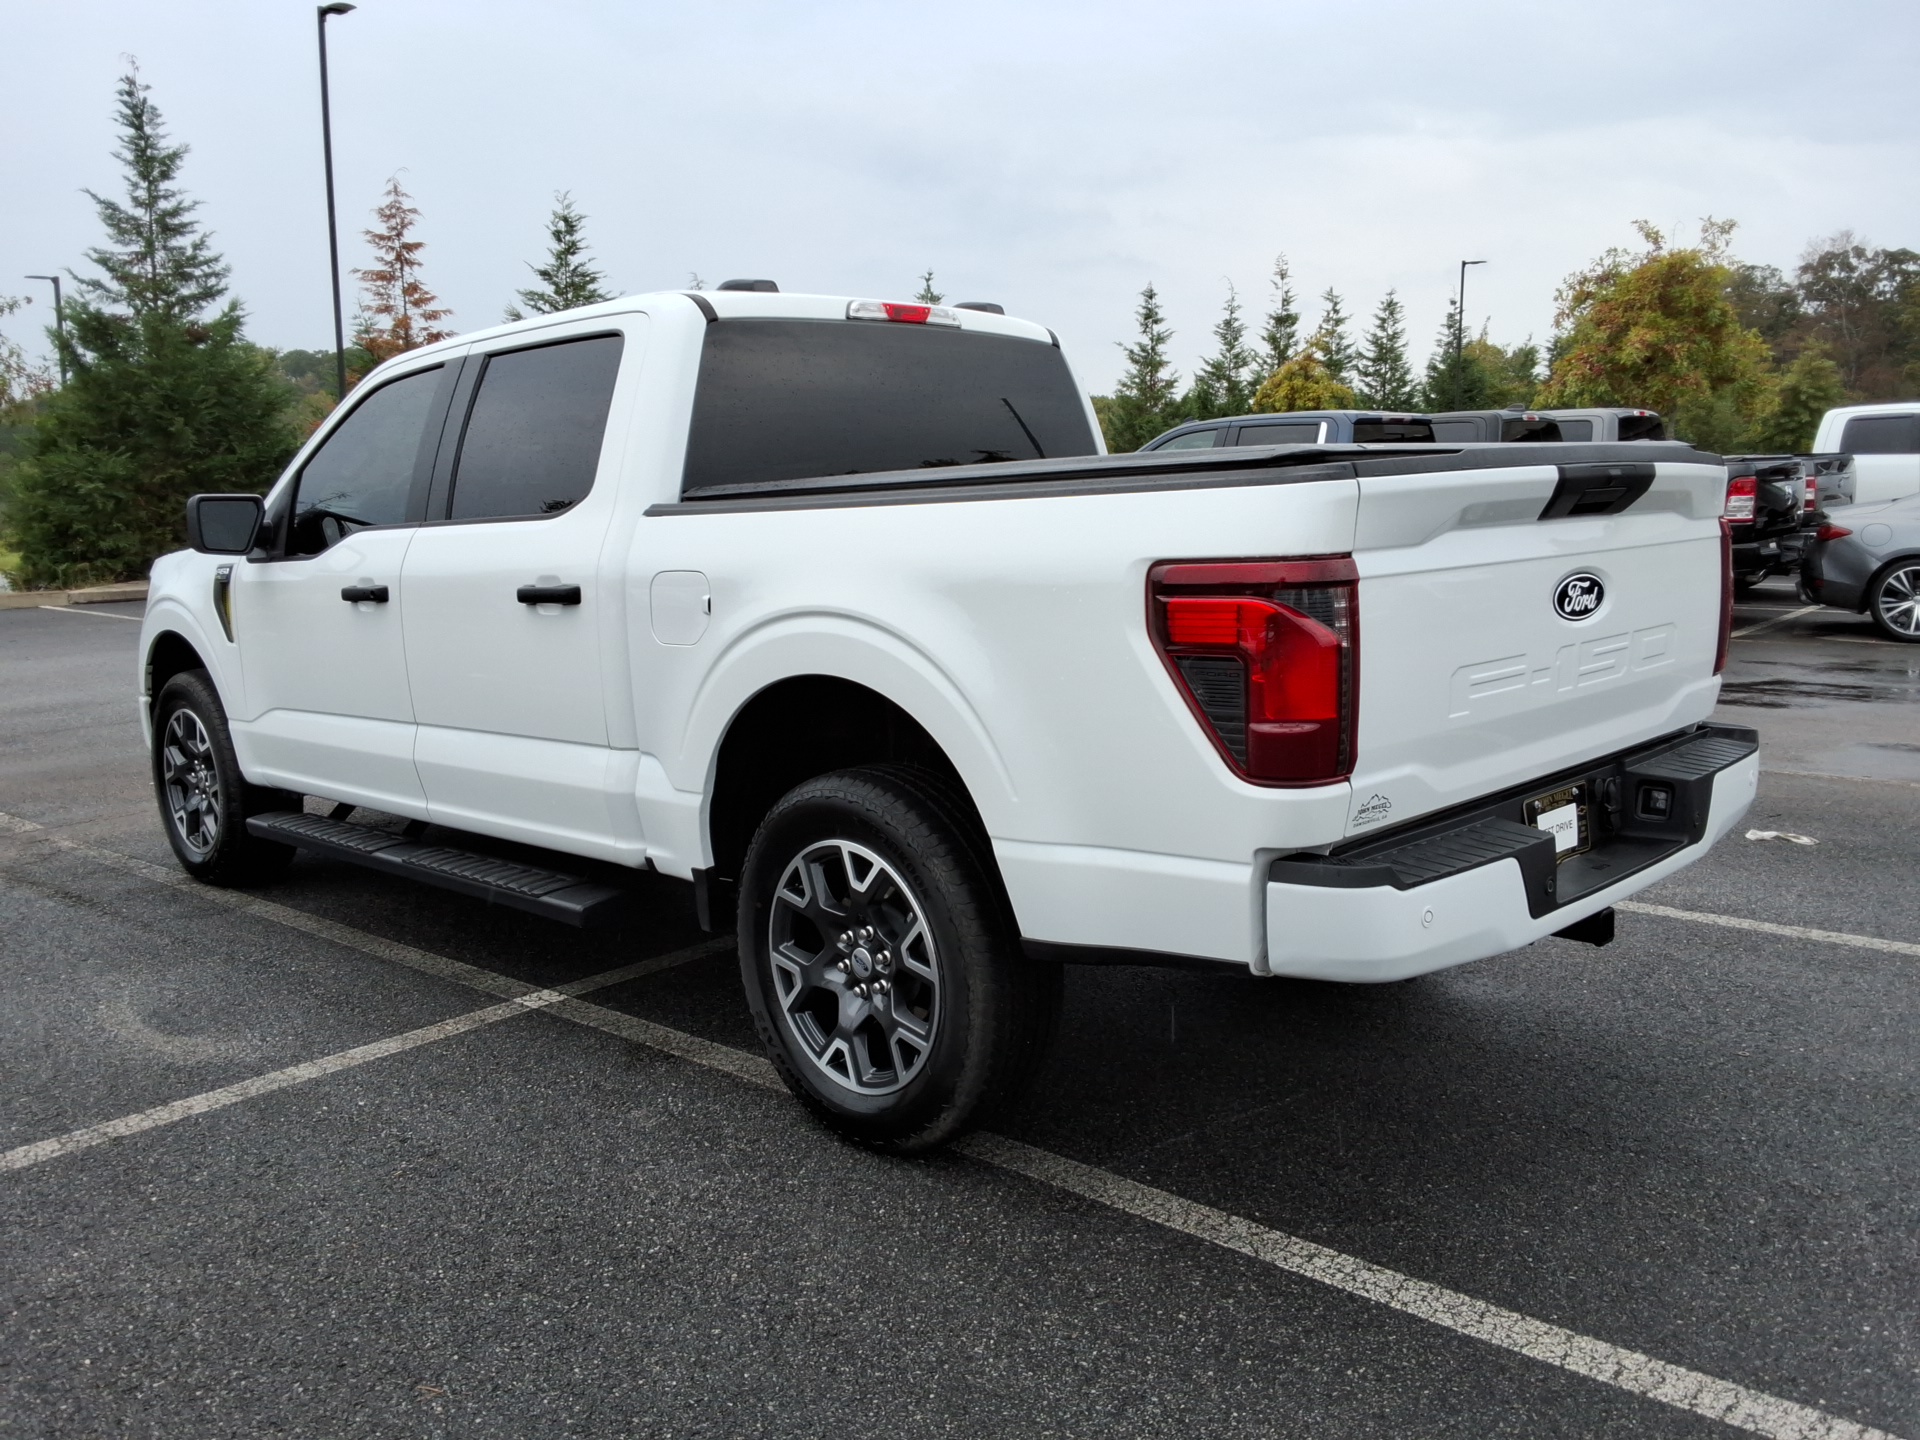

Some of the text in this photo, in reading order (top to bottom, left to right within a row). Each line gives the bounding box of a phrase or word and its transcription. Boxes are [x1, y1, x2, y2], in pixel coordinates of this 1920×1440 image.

[1564, 581, 1598, 612] Ford
[1448, 622, 1677, 719] F-150
[1556, 819, 1573, 833] DRIVE
